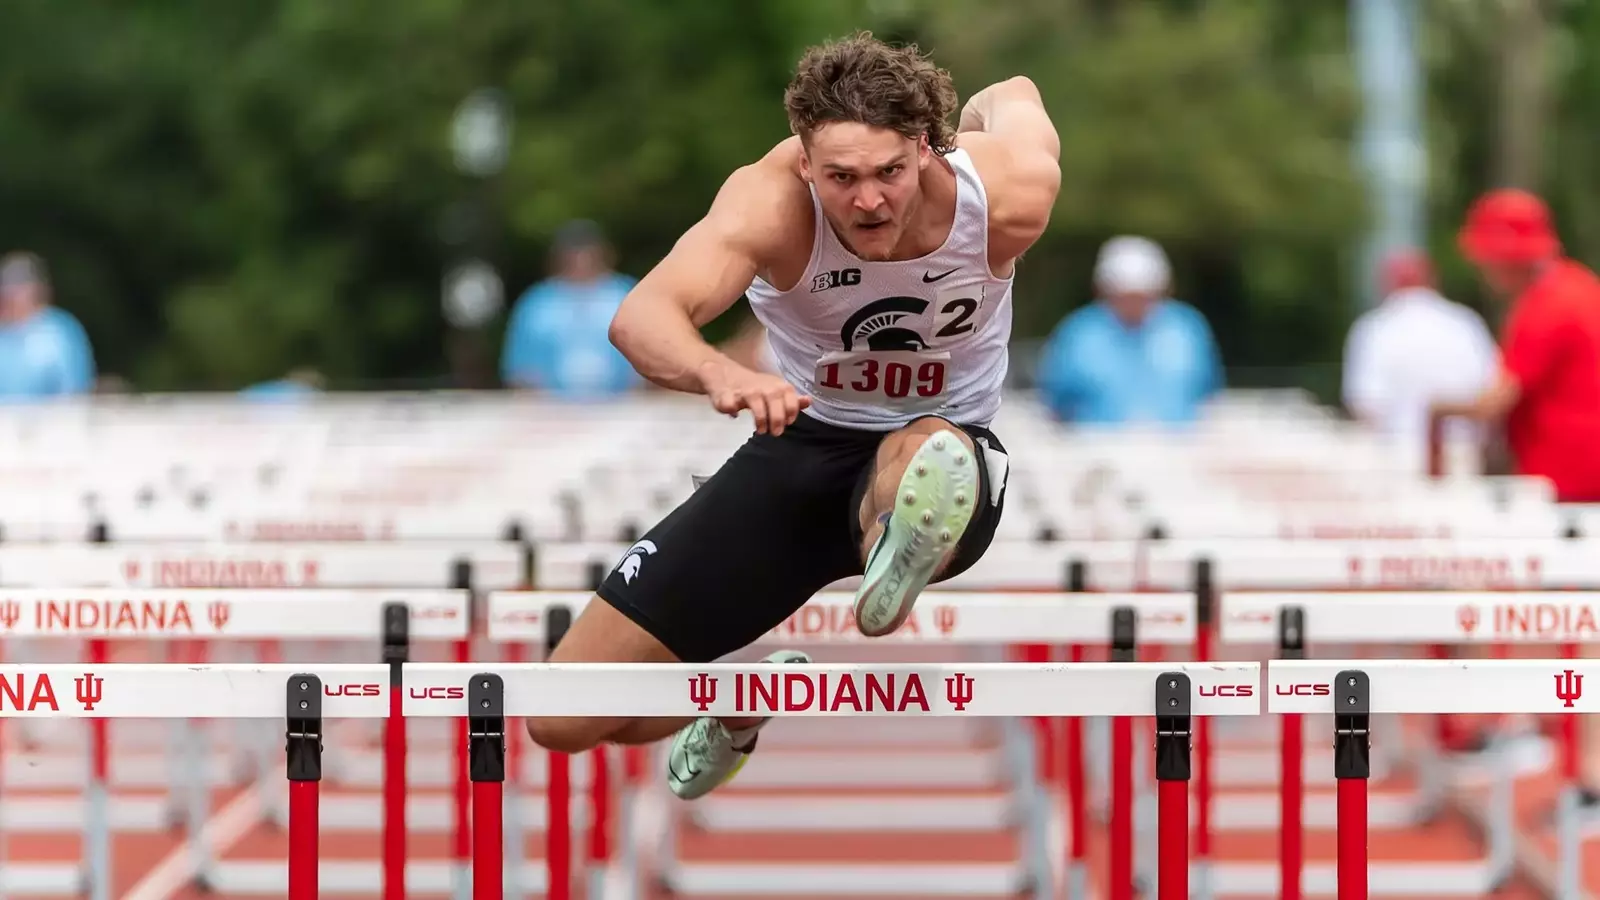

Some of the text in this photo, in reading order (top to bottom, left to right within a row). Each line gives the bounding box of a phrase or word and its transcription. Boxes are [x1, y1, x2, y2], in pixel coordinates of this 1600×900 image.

[935, 298, 978, 337] 2
[820, 359, 945, 398] 1309
[35, 600, 193, 630] INDIANA
[325, 684, 380, 696] UCS
[410, 687, 464, 699] UCS
[735, 673, 930, 711] INDIANA
[1199, 685, 1253, 697] UCS
[1276, 684, 1330, 696] UCS
